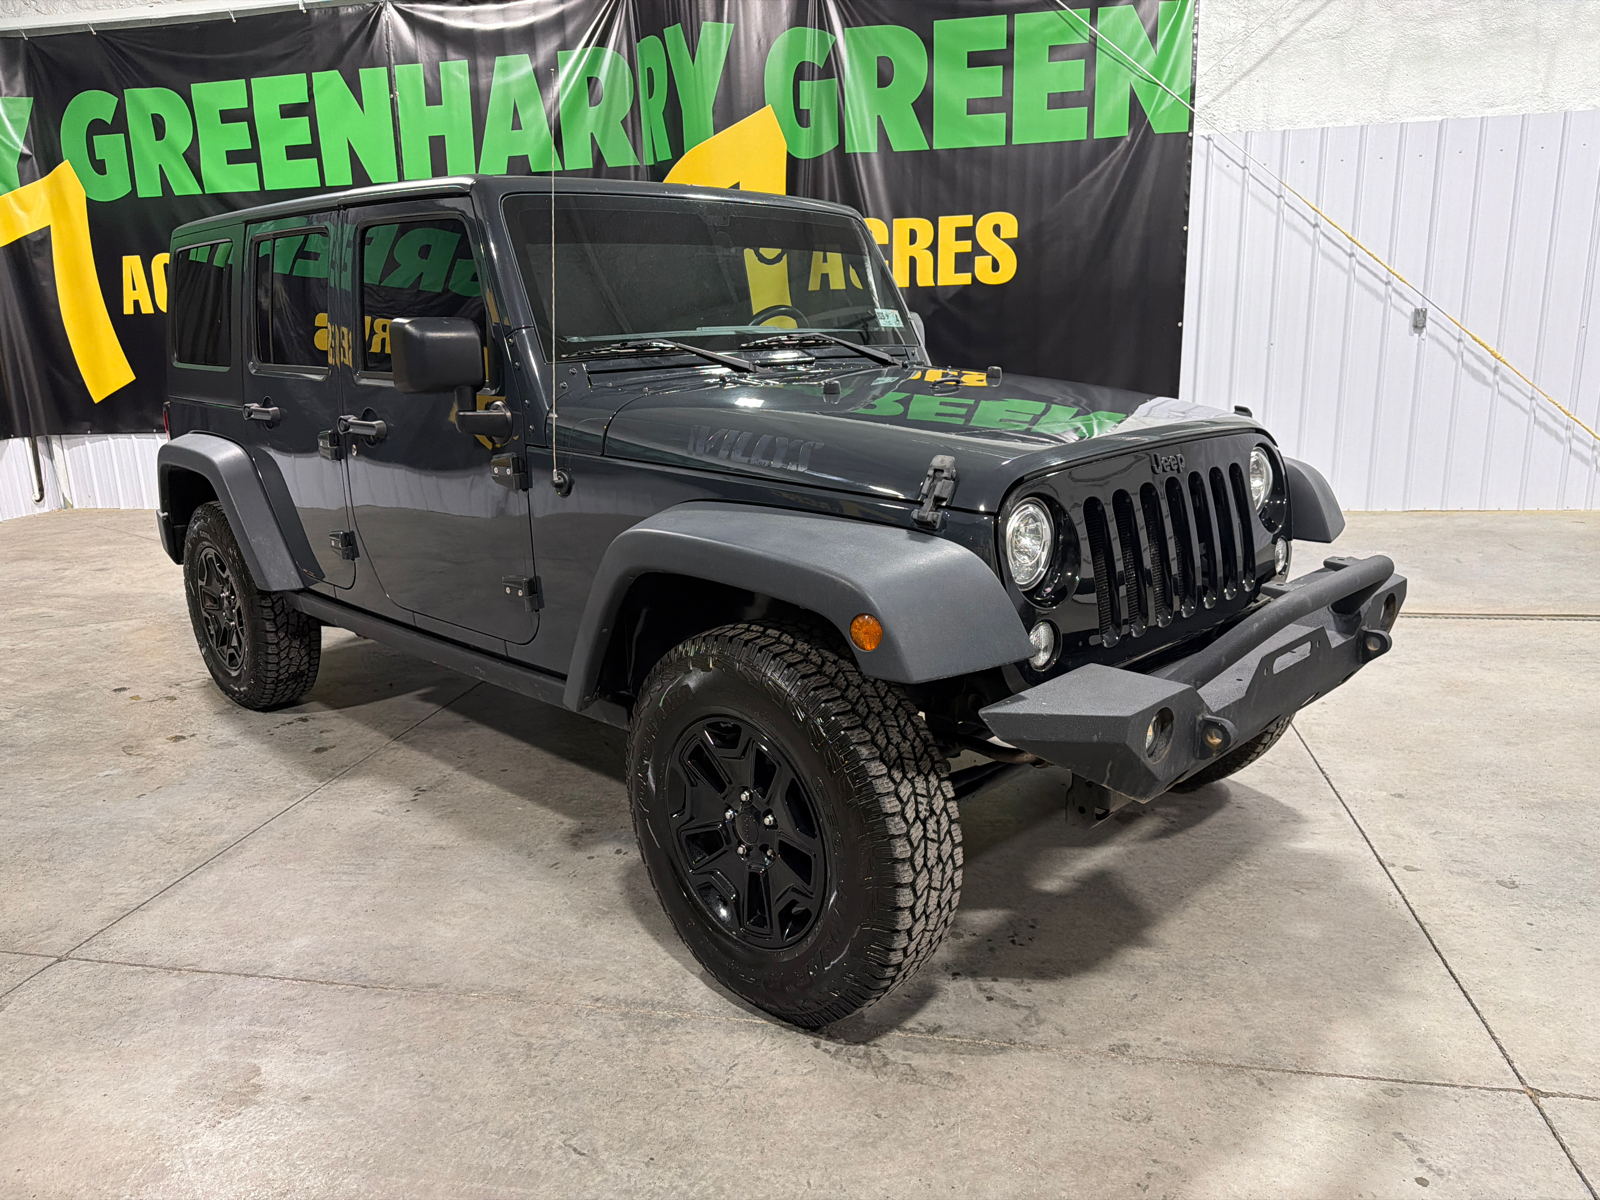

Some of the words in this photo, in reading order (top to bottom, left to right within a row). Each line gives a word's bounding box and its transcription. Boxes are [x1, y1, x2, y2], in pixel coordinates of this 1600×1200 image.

[60, 66, 399, 202] GREEN
[394, 22, 735, 181] HARRY
[763, 1, 1193, 160] GREEN
[1151, 452, 1187, 475] Jeep
